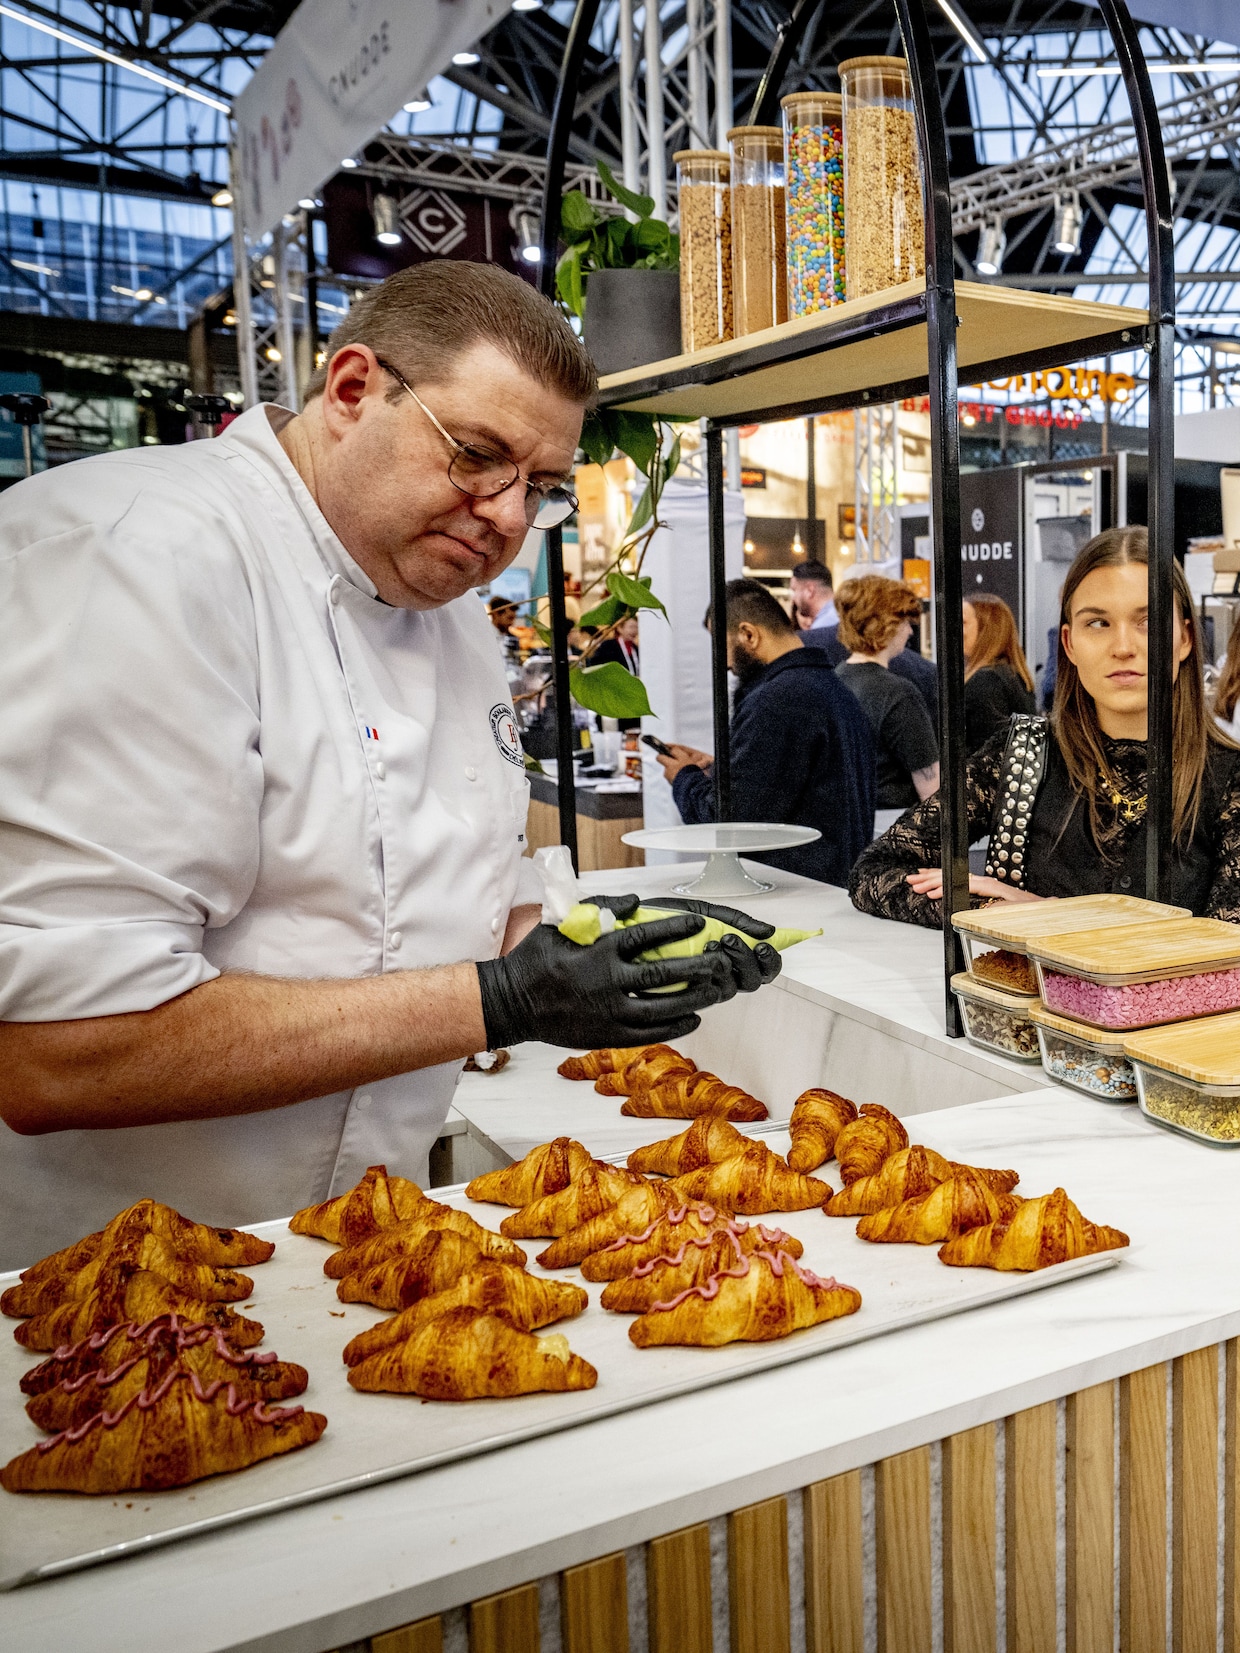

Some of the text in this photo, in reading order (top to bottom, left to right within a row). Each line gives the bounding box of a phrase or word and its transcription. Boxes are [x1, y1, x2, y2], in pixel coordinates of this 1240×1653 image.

[969, 366, 1136, 403] rraine
[902, 396, 1083, 430] BARY GROUP
[960, 541, 1013, 561] NUDDE
